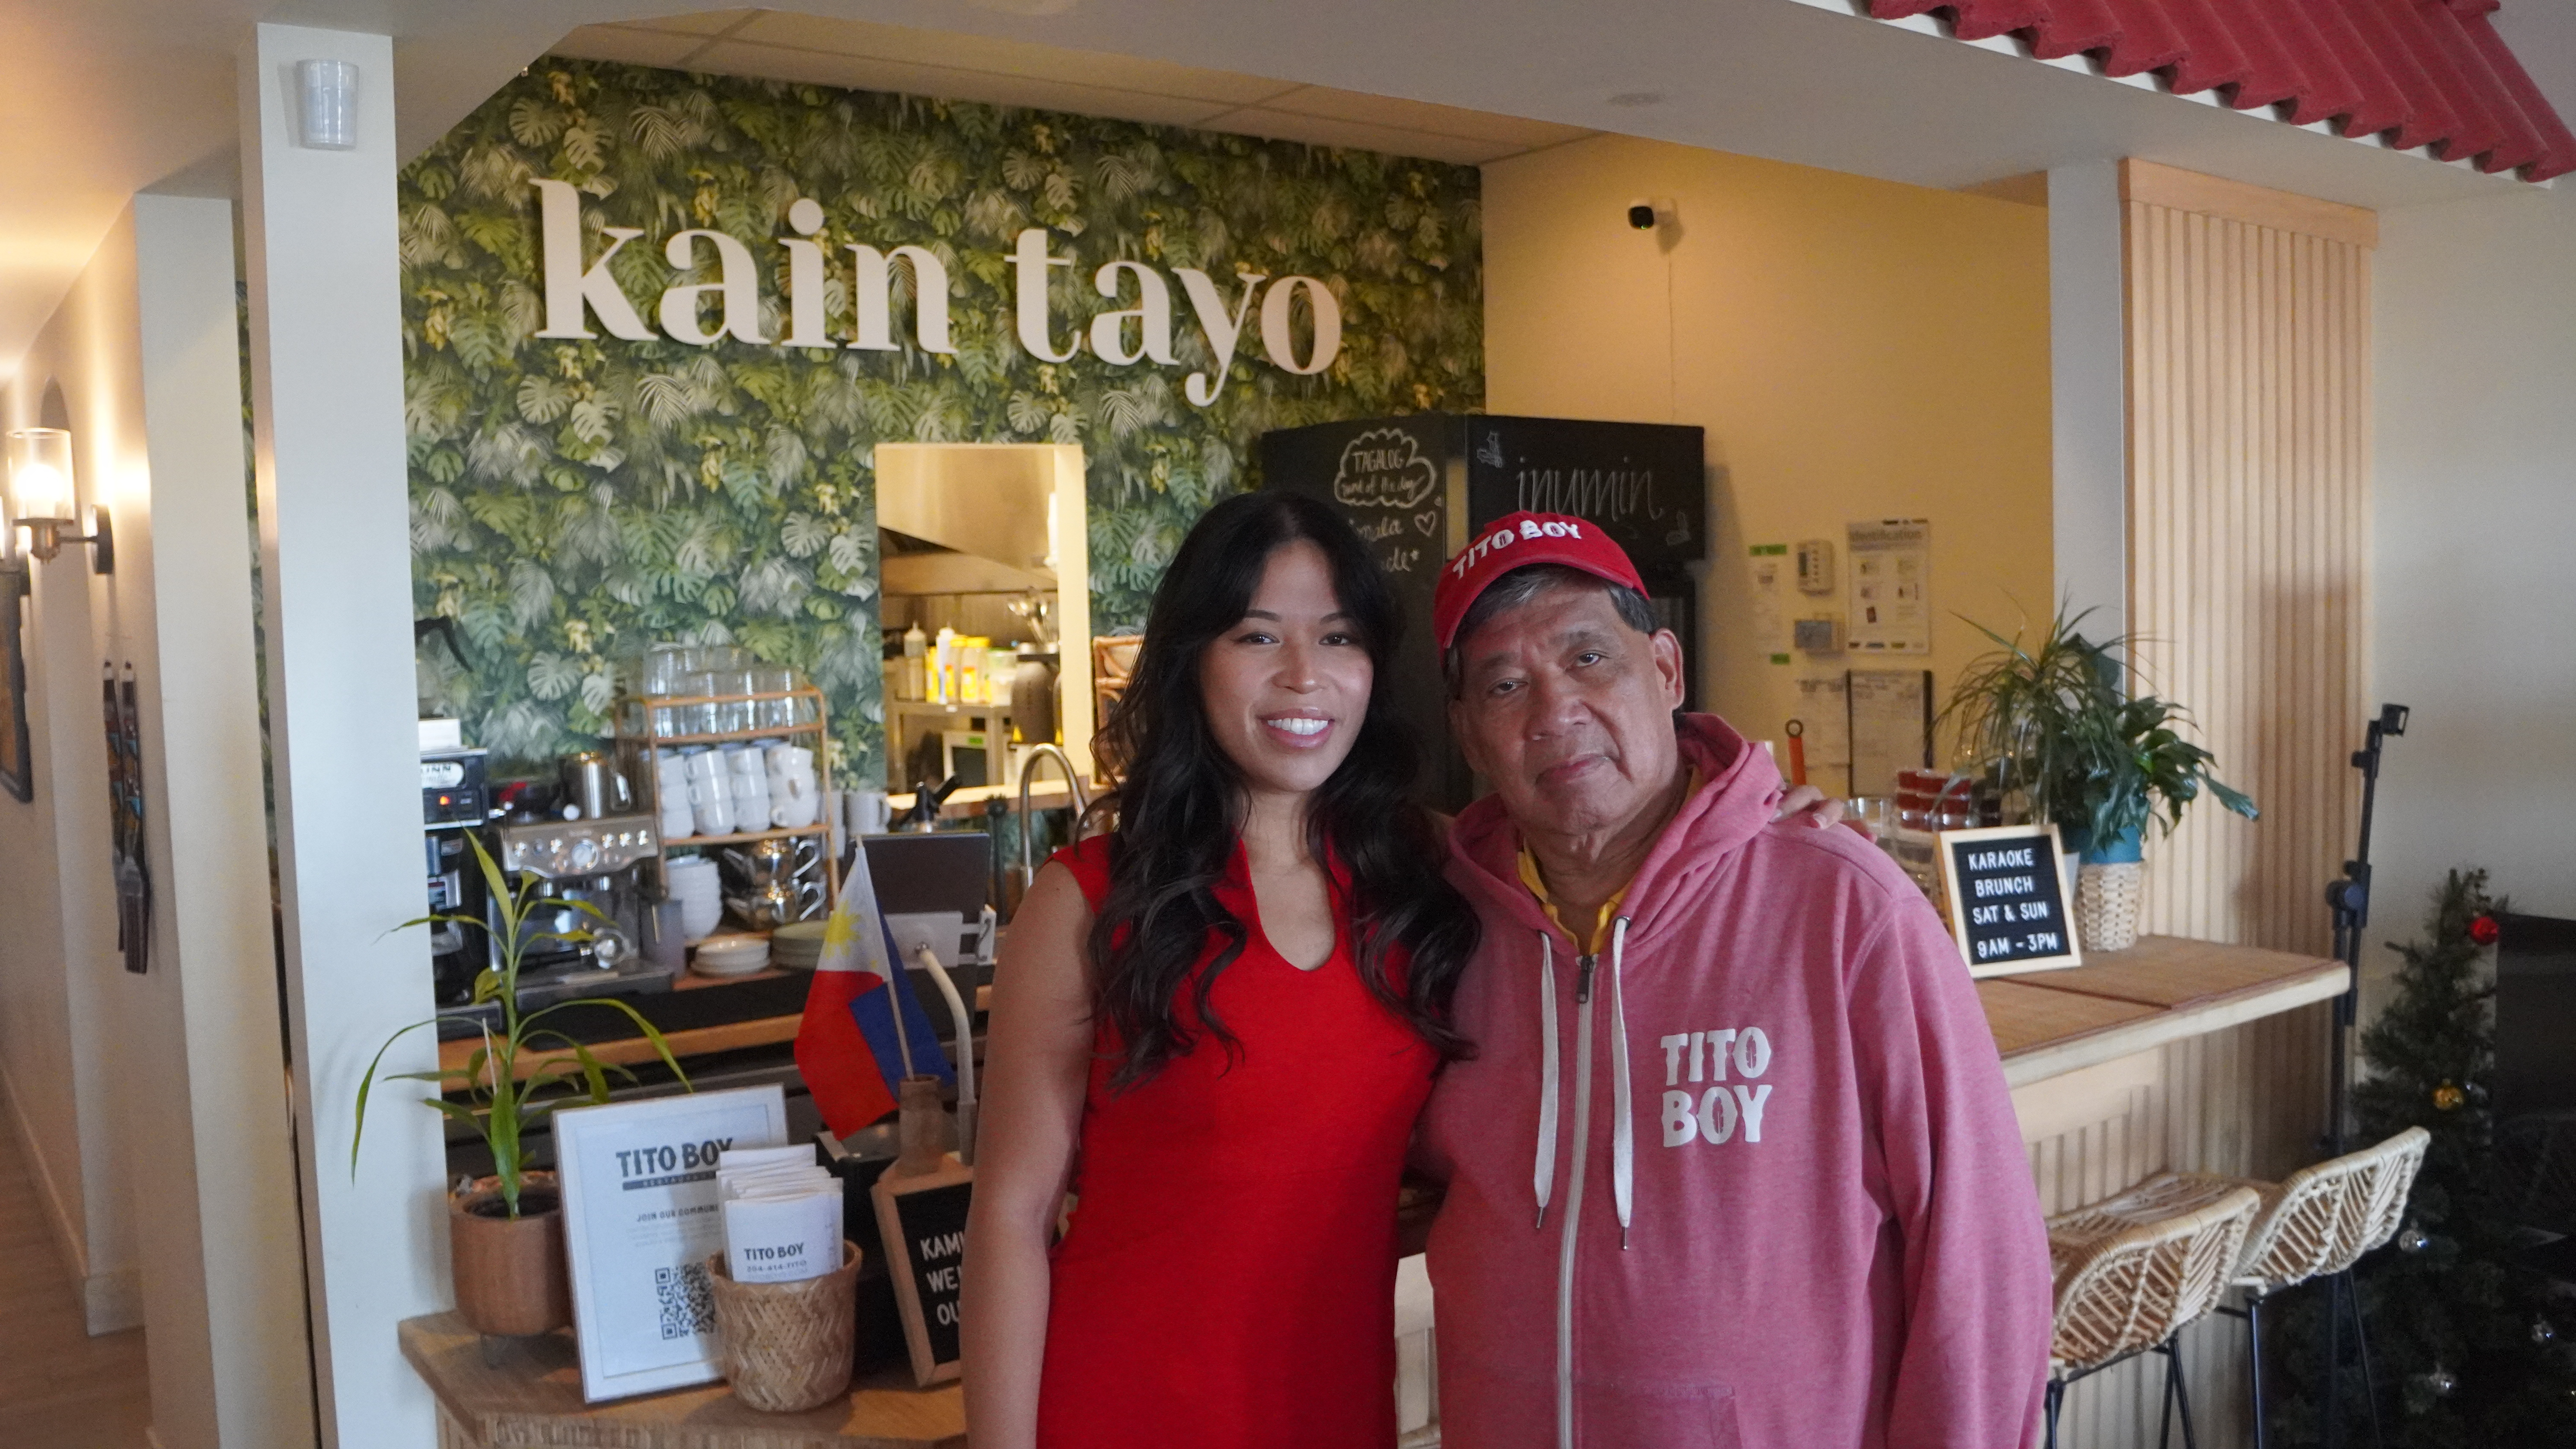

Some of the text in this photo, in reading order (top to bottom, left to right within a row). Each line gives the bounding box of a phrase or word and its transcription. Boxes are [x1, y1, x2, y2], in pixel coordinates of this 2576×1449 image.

[529, 178, 1342, 406] kain tayo
[1452, 520, 1582, 579] TITO BOY
[1968, 848, 2034, 872] KARAOKE
[1975, 875, 2033, 898] BRUNCH
[1973, 901, 2048, 925] SAT & SUN
[1977, 937, 2010, 958] 9AM
[2027, 932, 2058, 952] 3PM
[1661, 1027, 1771, 1086] TITO
[1661, 1085, 1772, 1147] BOY
[616, 1137, 732, 1178] TITO BOY
[637, 1212, 657, 1222] JOIN
[659, 1210, 676, 1219] OUR
[744, 1242, 805, 1261] TITO BOY
